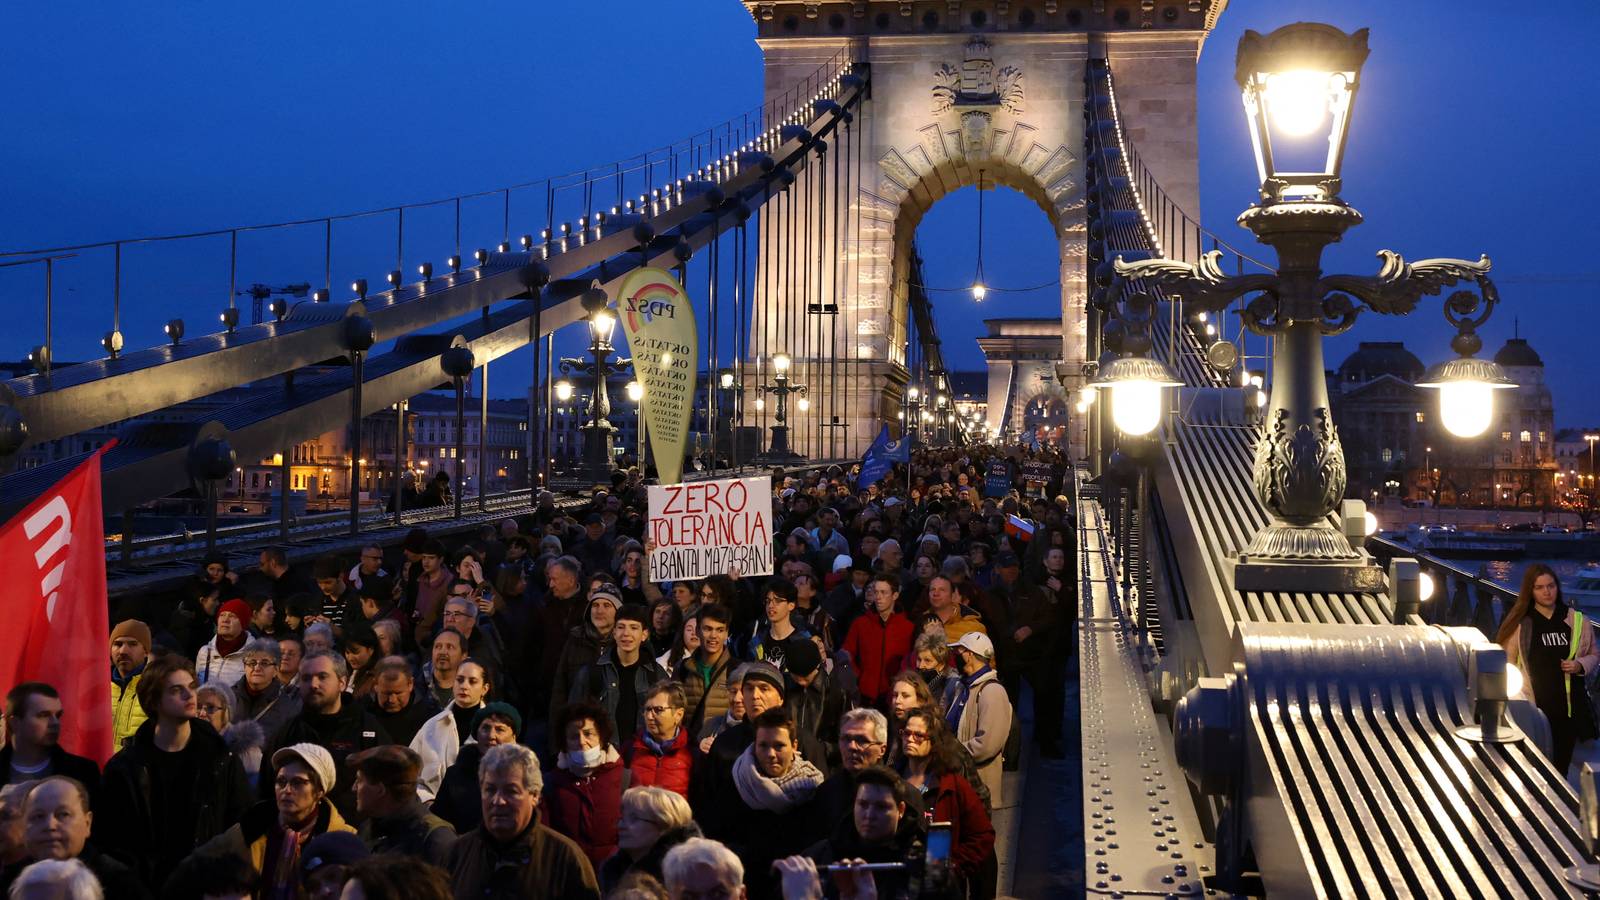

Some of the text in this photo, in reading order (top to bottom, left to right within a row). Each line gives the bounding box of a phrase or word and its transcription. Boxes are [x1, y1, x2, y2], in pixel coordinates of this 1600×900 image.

[663, 479, 747, 515] ZERÓ
[650, 511, 768, 547] TOLERANCIA
[650, 553, 658, 579] A
